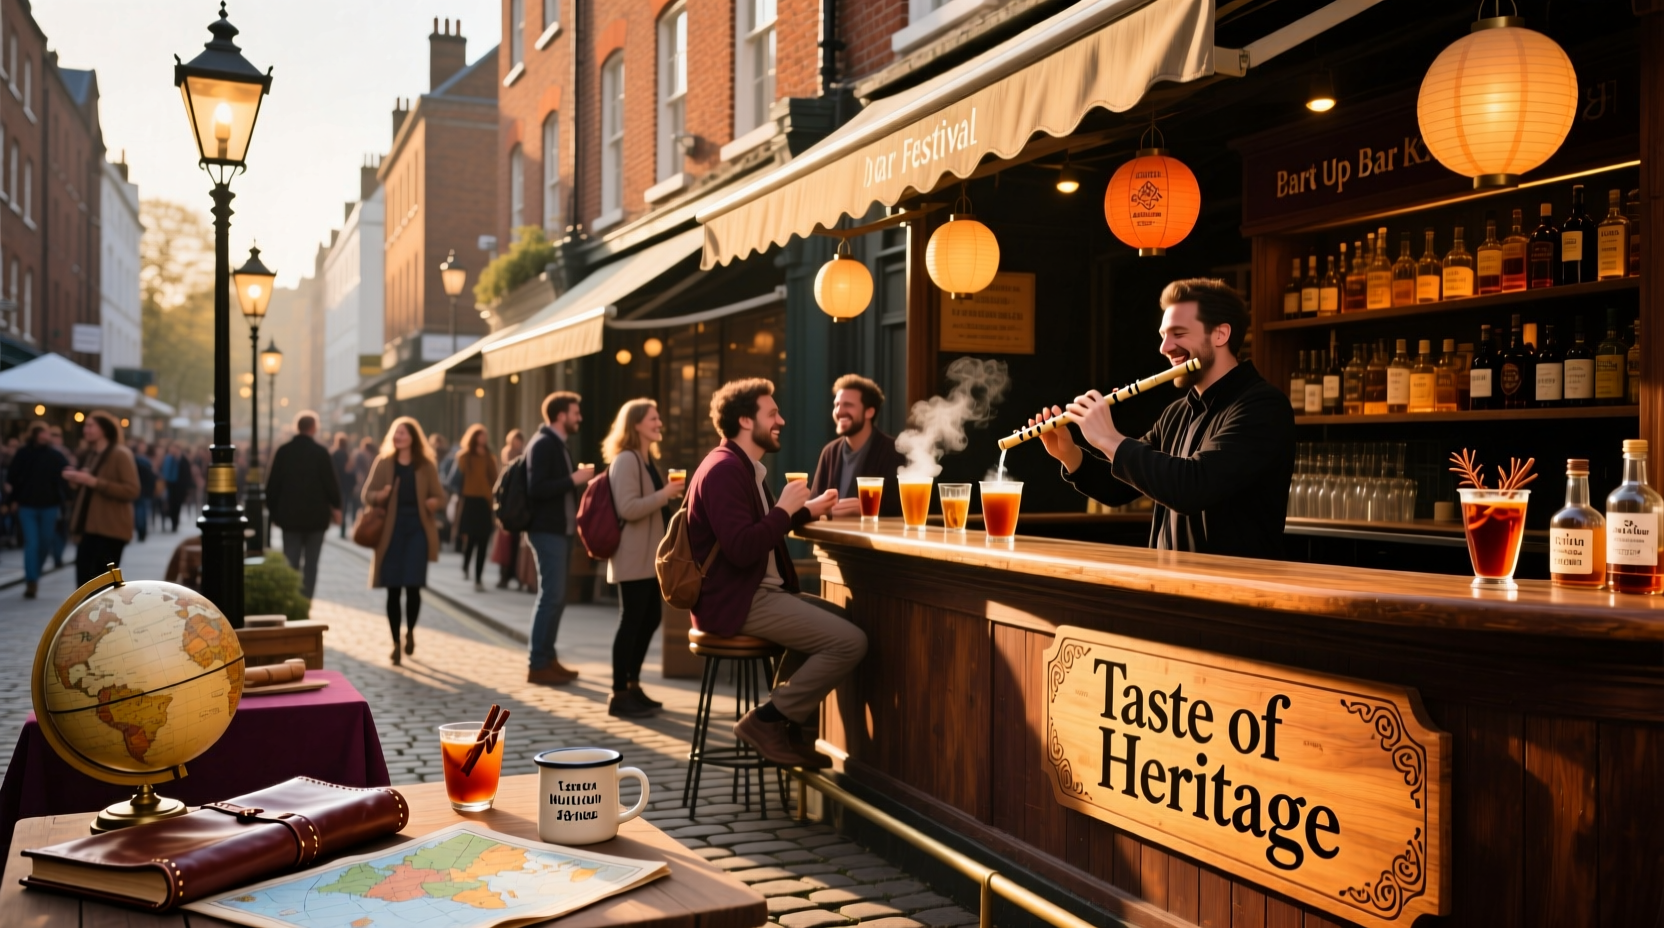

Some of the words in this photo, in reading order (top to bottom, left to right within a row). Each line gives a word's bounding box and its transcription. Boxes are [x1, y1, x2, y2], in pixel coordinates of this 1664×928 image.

[901, 107, 977, 174] Festival
[1276, 163, 1316, 198] Bart
[1323, 157, 1350, 193] Up
[1358, 147, 1398, 178] Bar
[1093, 658, 1214, 744] Taste
[1228, 694, 1291, 762] of
[1097, 725, 1341, 871] Heritage
